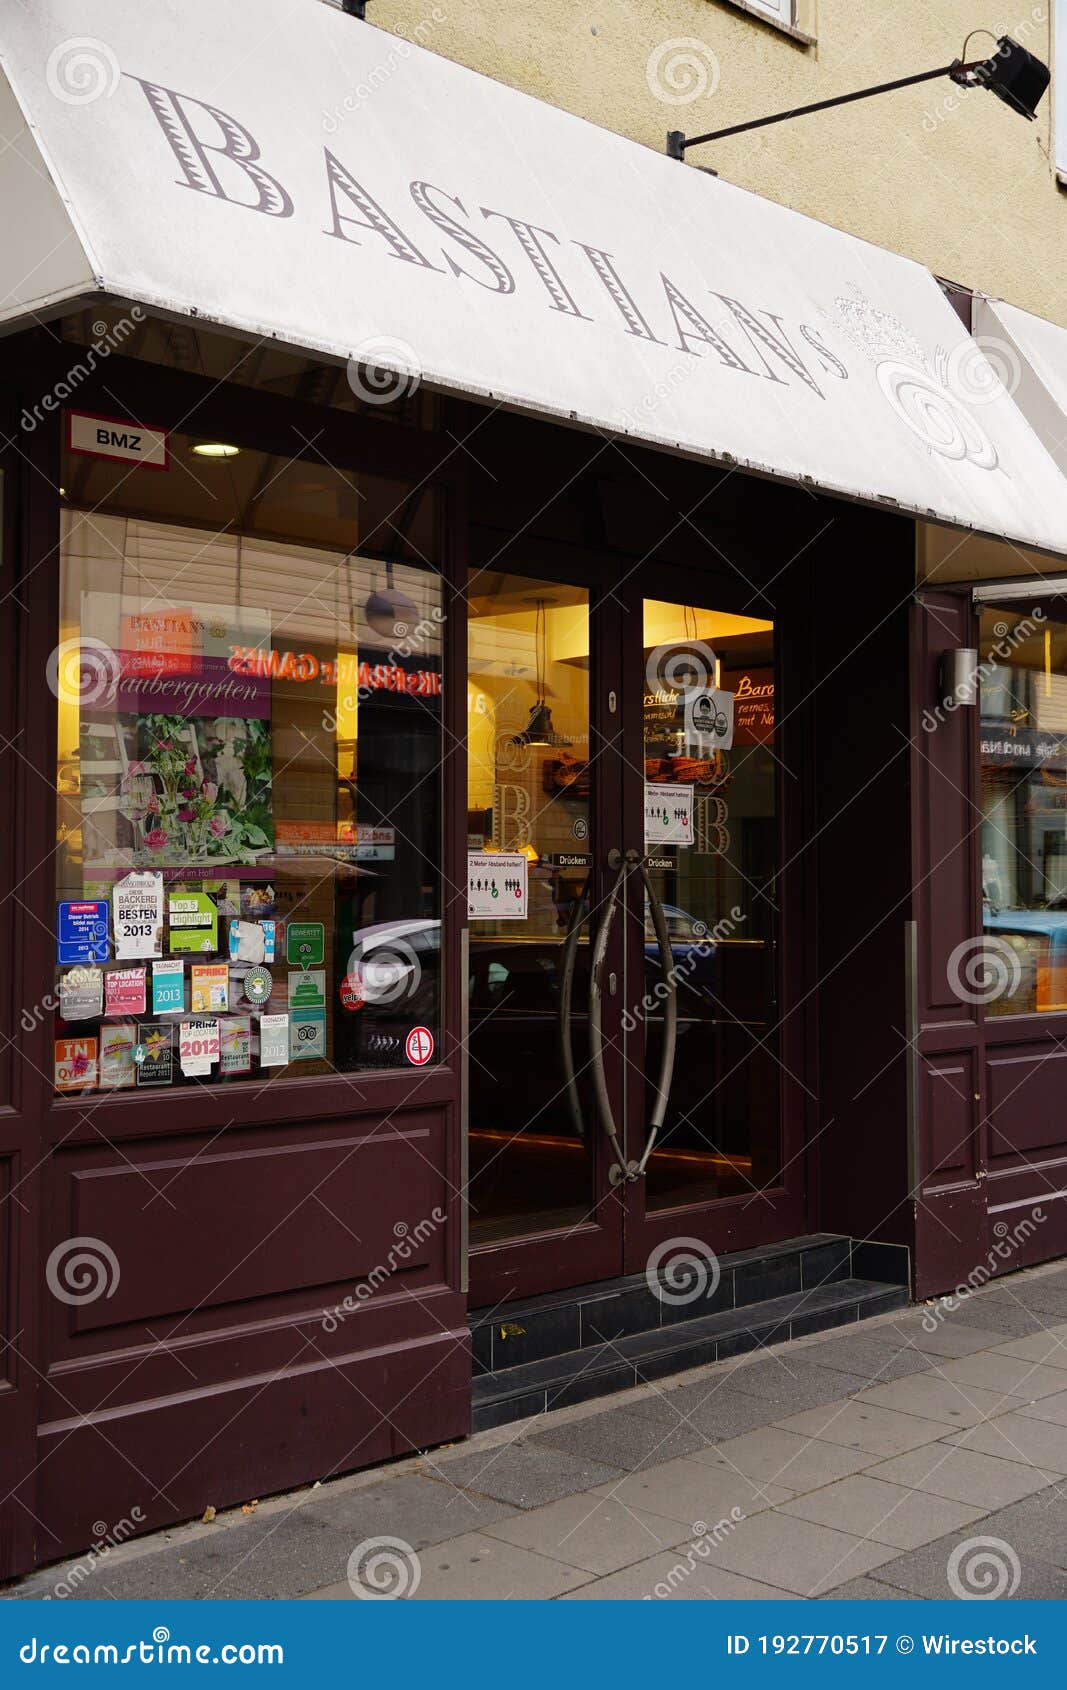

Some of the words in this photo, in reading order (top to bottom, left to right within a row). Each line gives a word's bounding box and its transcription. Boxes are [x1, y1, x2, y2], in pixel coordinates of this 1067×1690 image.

[96, 428, 142, 452] BMZ
[492, 784, 532, 849] B
[693, 796, 731, 855] B
[559, 854, 586, 865] Drücken
[648, 858, 673, 868] Drücken
[173, 901, 189, 910] Top
[190, 900, 196, 909] 5
[119, 909, 157, 920] BESTEN
[173, 913, 211, 924] Highlight
[123, 925, 152, 937] 2013
[118, 980, 143, 988] LOCATION
[157, 989, 181, 1002] 2013
[189, 1019, 217, 1030] PRINZ
[63, 1044, 88, 1061] IN
[181, 1038, 219, 1057] 2012
[263, 1045, 286, 1058] 2012
